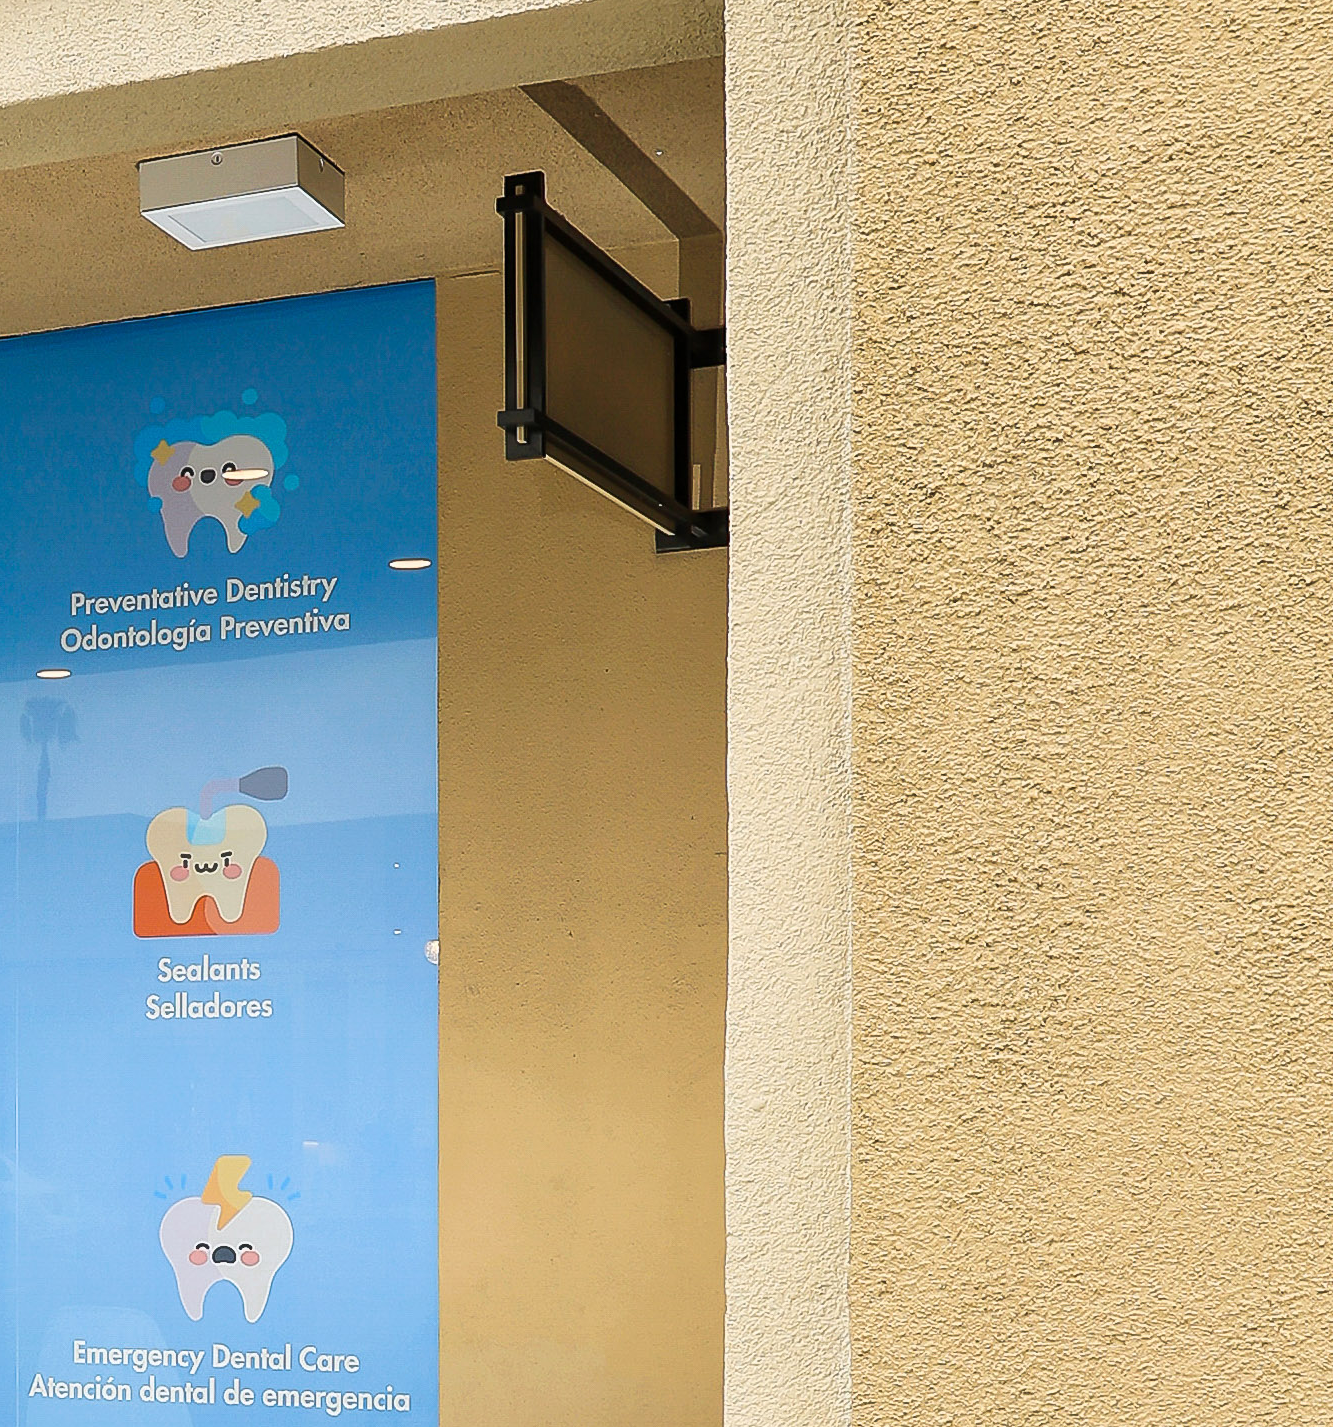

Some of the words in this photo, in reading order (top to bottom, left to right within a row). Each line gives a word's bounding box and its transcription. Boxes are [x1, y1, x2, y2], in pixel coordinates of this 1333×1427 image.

[70, 582, 218, 616] Preventative
[226, 573, 338, 603] Dentistry
[60, 618, 211, 652] Odontología
[220, 608, 350, 640] Preventiva
[157, 954, 261, 983] Sealants
[145, 992, 273, 1020] Selladores
[73, 1340, 205, 1374] Emergency
[212, 1342, 291, 1371] Dental
[298, 1346, 360, 1374] Care
[28, 1373, 131, 1403] Atención
[139, 1375, 216, 1406] dental
[223, 1378, 255, 1407] de
[262, 1385, 411, 1417] emergencia
